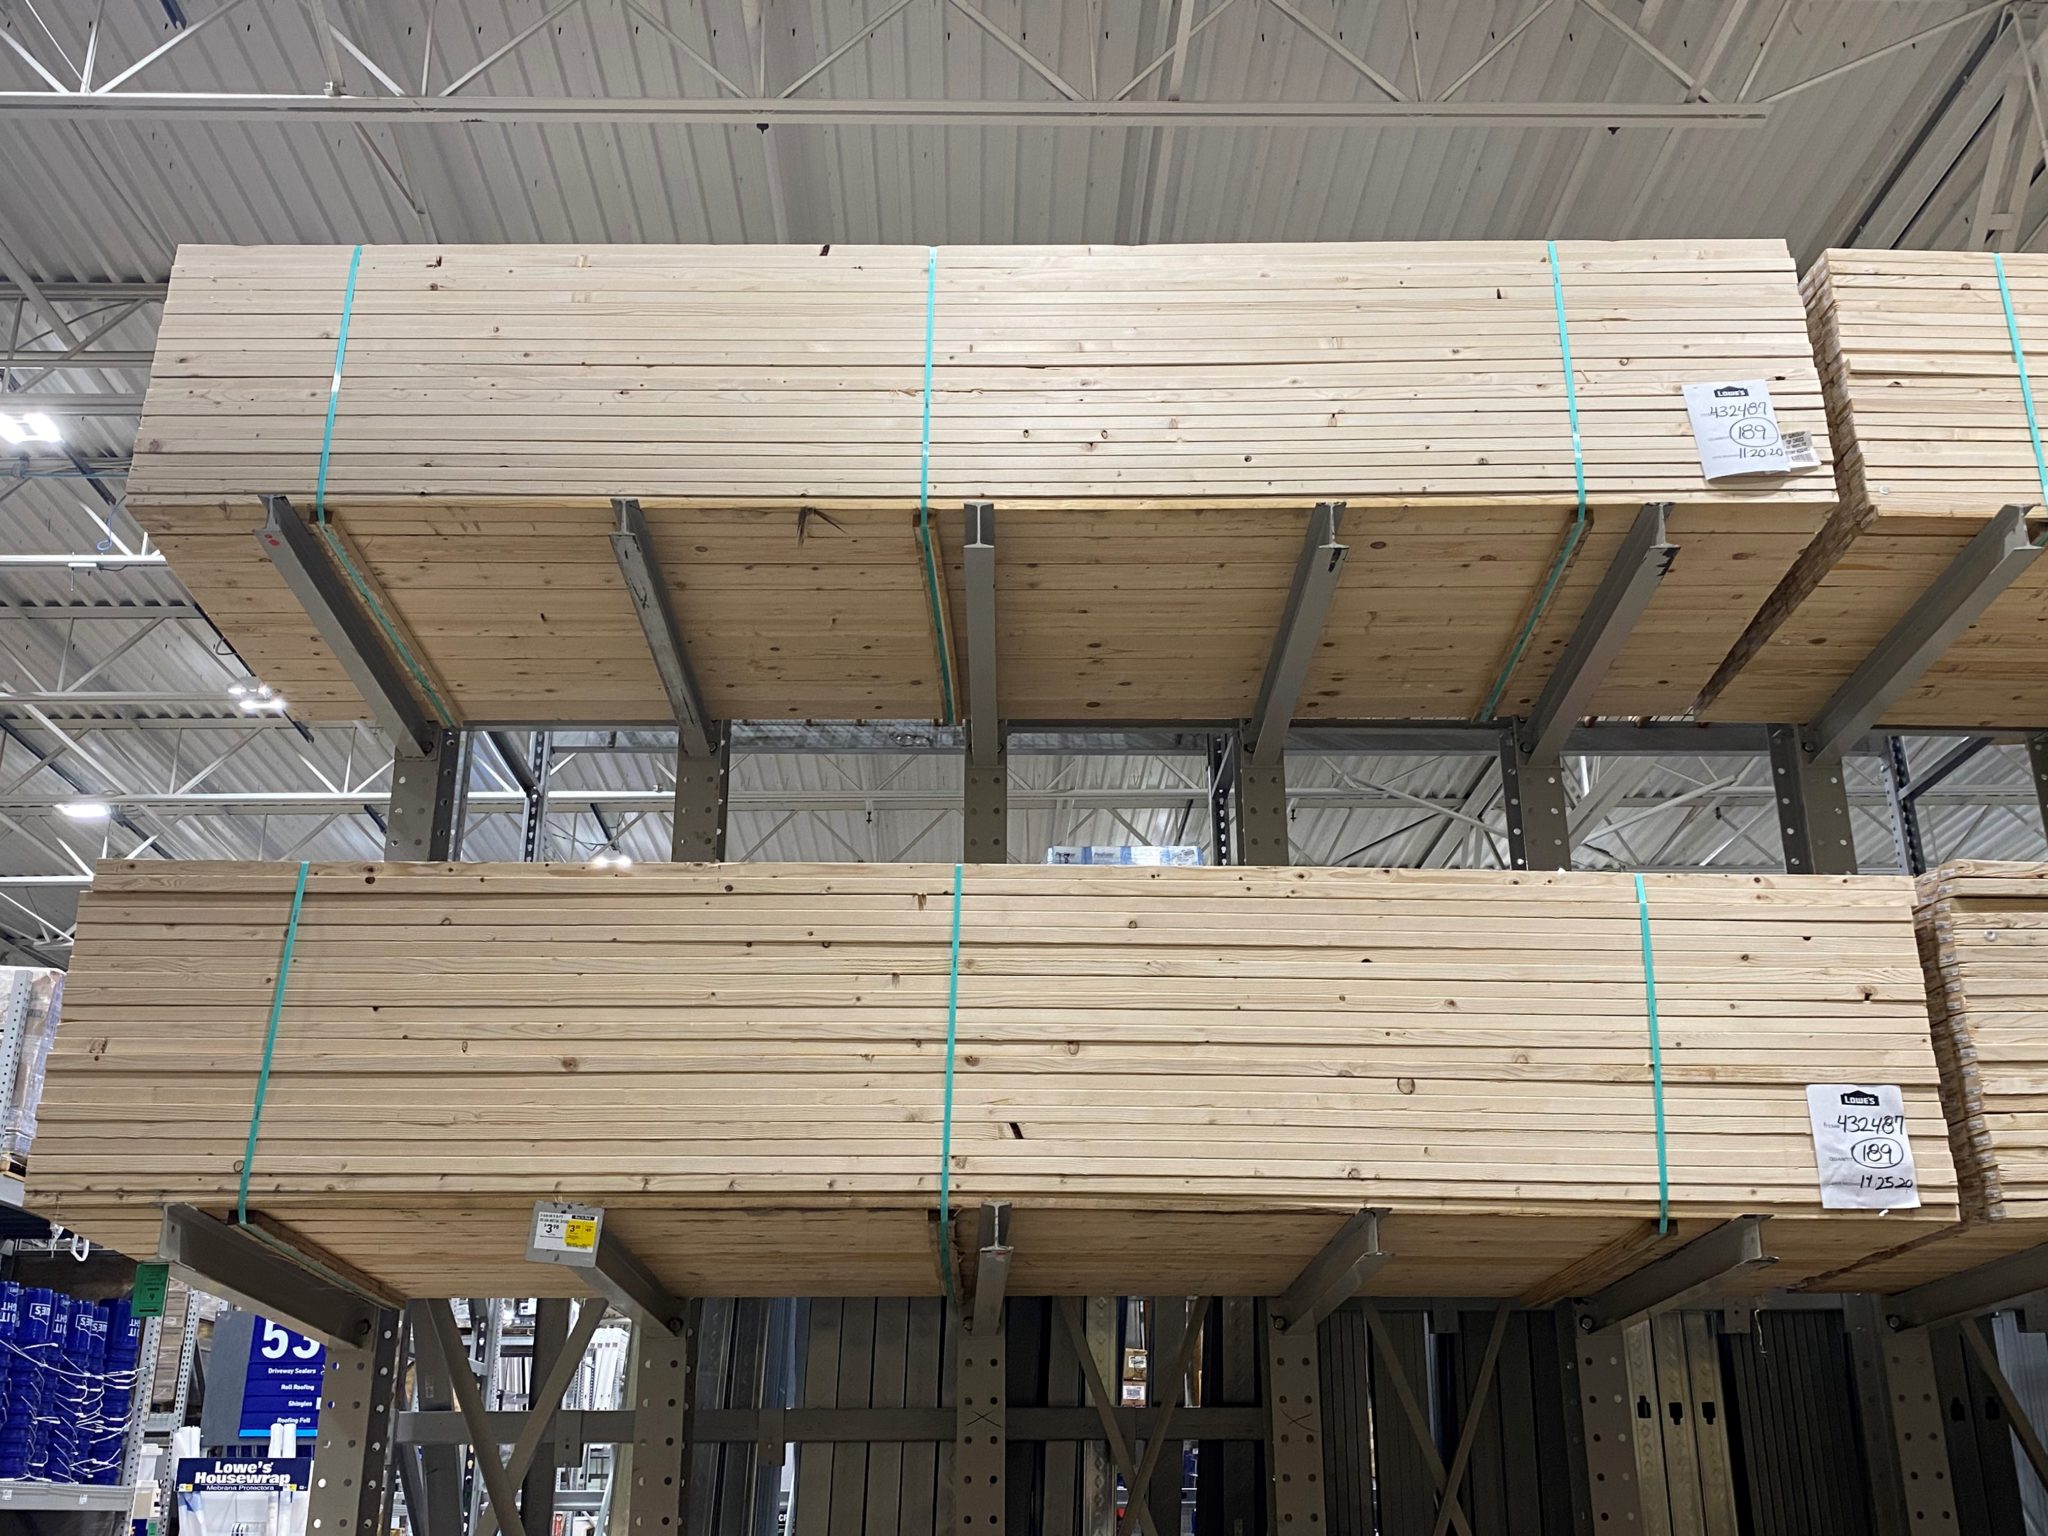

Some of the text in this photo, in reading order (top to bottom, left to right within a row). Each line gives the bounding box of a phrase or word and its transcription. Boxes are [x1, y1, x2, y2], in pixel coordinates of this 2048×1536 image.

[1709, 401, 1767, 418] 432487
[1738, 424, 1767, 440] 189
[1843, 1096, 1876, 1105] LOWE'S
[1837, 1114, 1904, 1135] 432487
[1862, 1143, 1893, 1164] 189
[214, 1461, 274, 1474] Lowe's
[194, 1471, 291, 1486] Housewrap
